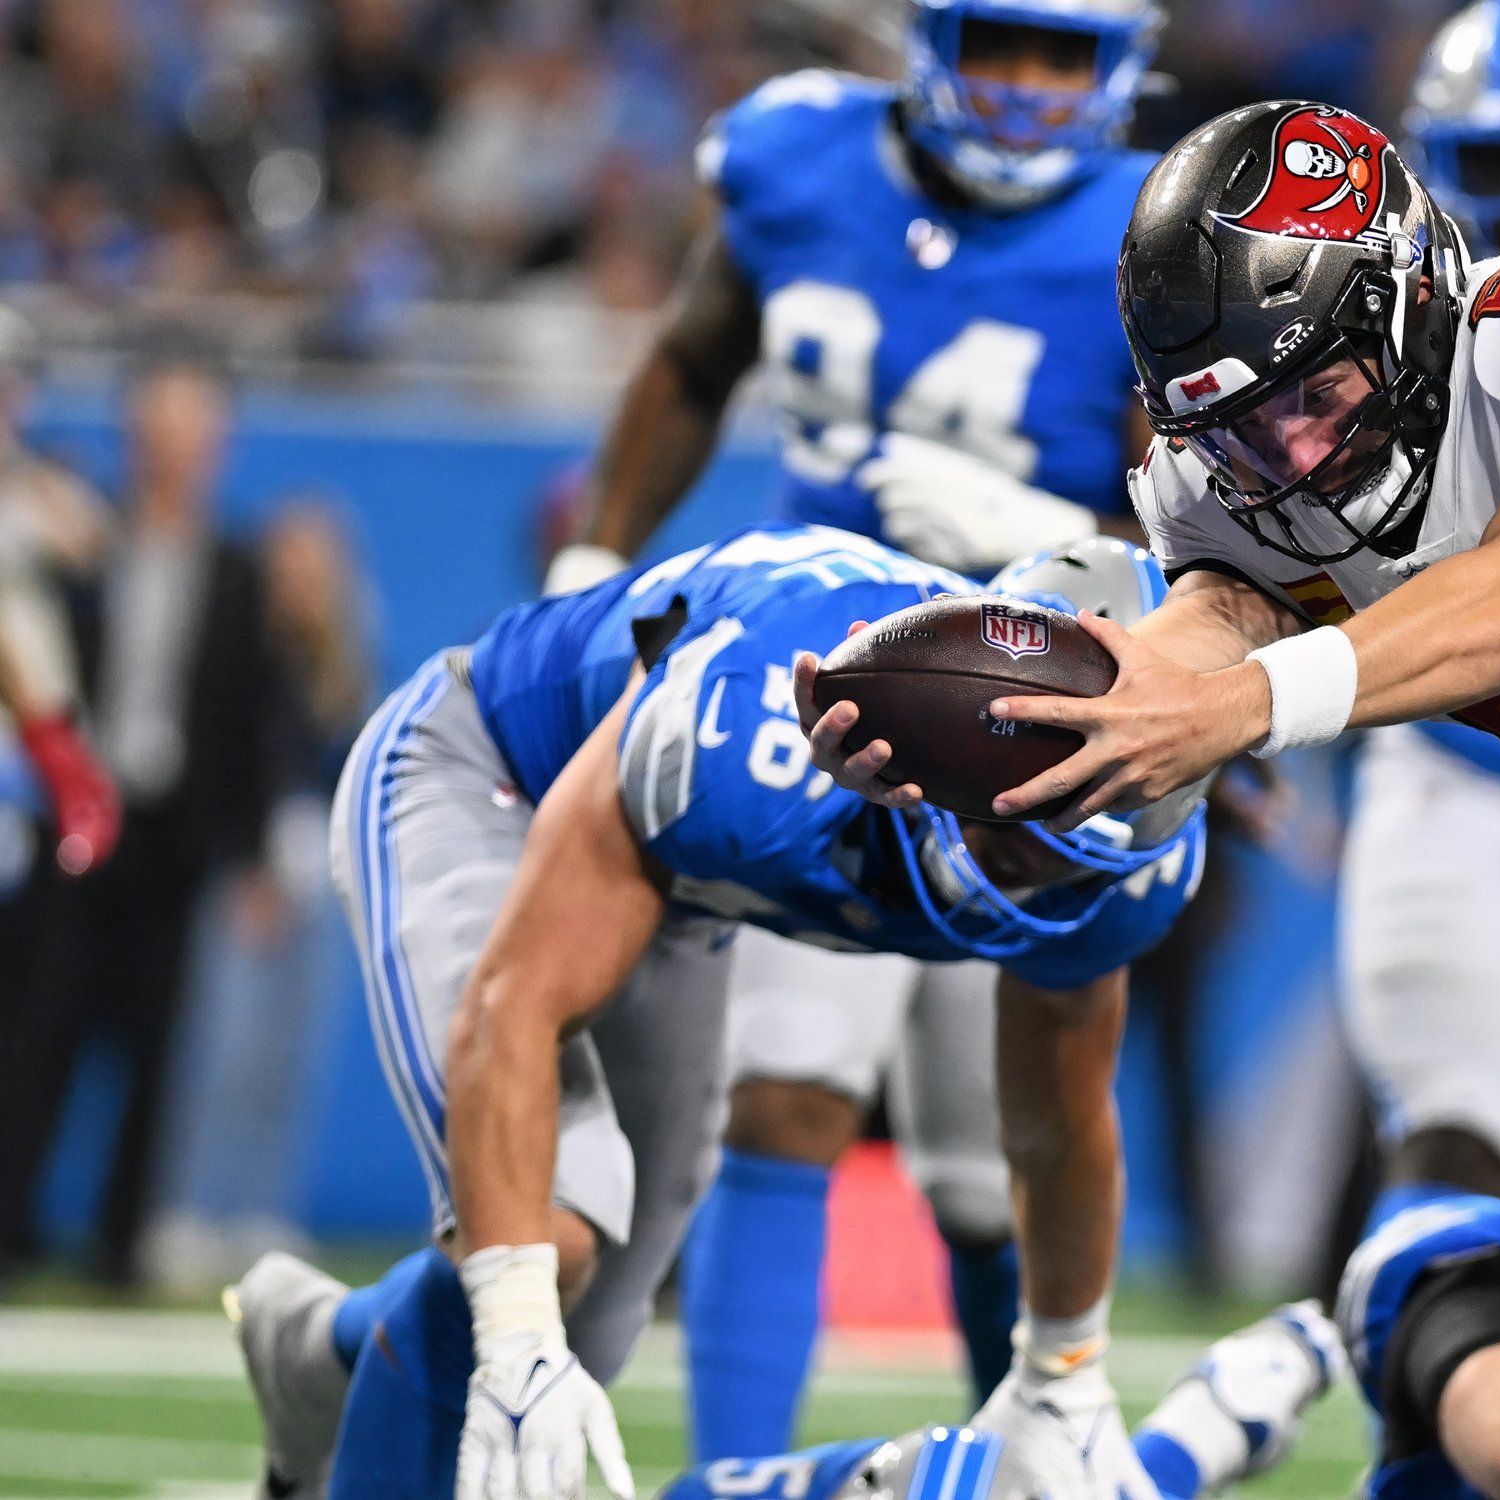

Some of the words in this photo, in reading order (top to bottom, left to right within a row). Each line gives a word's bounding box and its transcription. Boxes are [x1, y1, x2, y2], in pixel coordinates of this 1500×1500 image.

[1273, 323, 1315, 364] OAKLEY
[760, 278, 1048, 490] 94
[989, 616, 1043, 648] NFL
